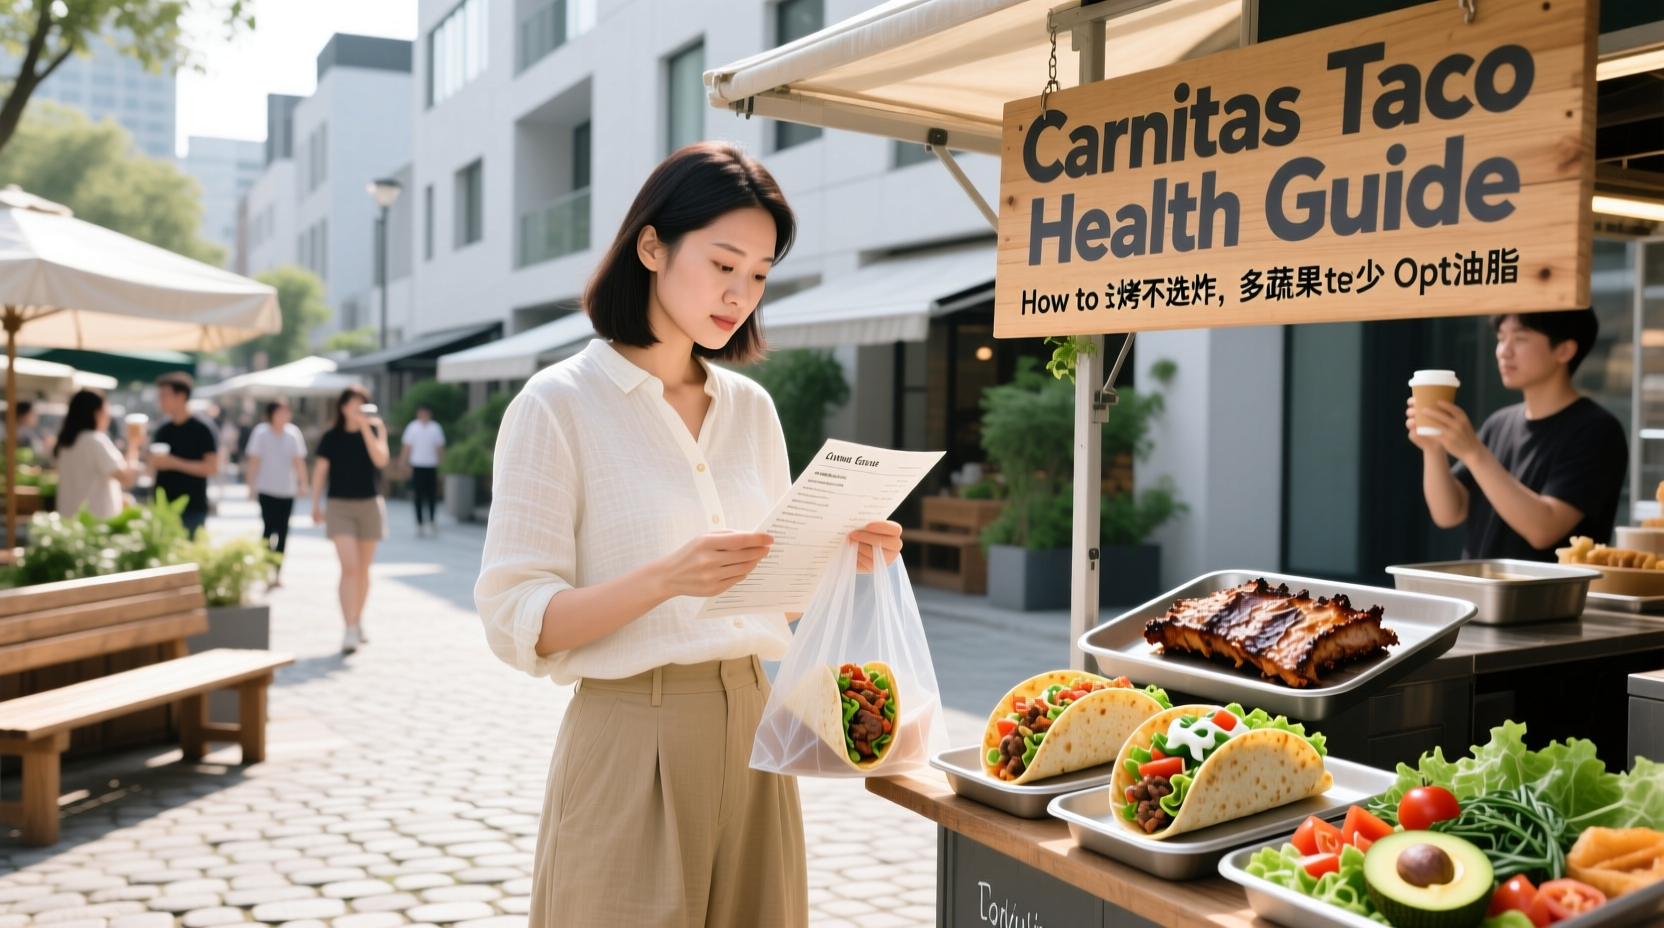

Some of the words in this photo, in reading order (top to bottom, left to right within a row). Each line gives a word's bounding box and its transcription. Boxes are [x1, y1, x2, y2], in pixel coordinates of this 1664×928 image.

[1022, 82, 1301, 183] Carnitas
[1326, 41, 1536, 135] Taco
[1028, 171, 1241, 265] Health
[1265, 135, 1521, 241] Guide
[1021, 289, 1070, 315] How
[1075, 287, 1099, 311] to
